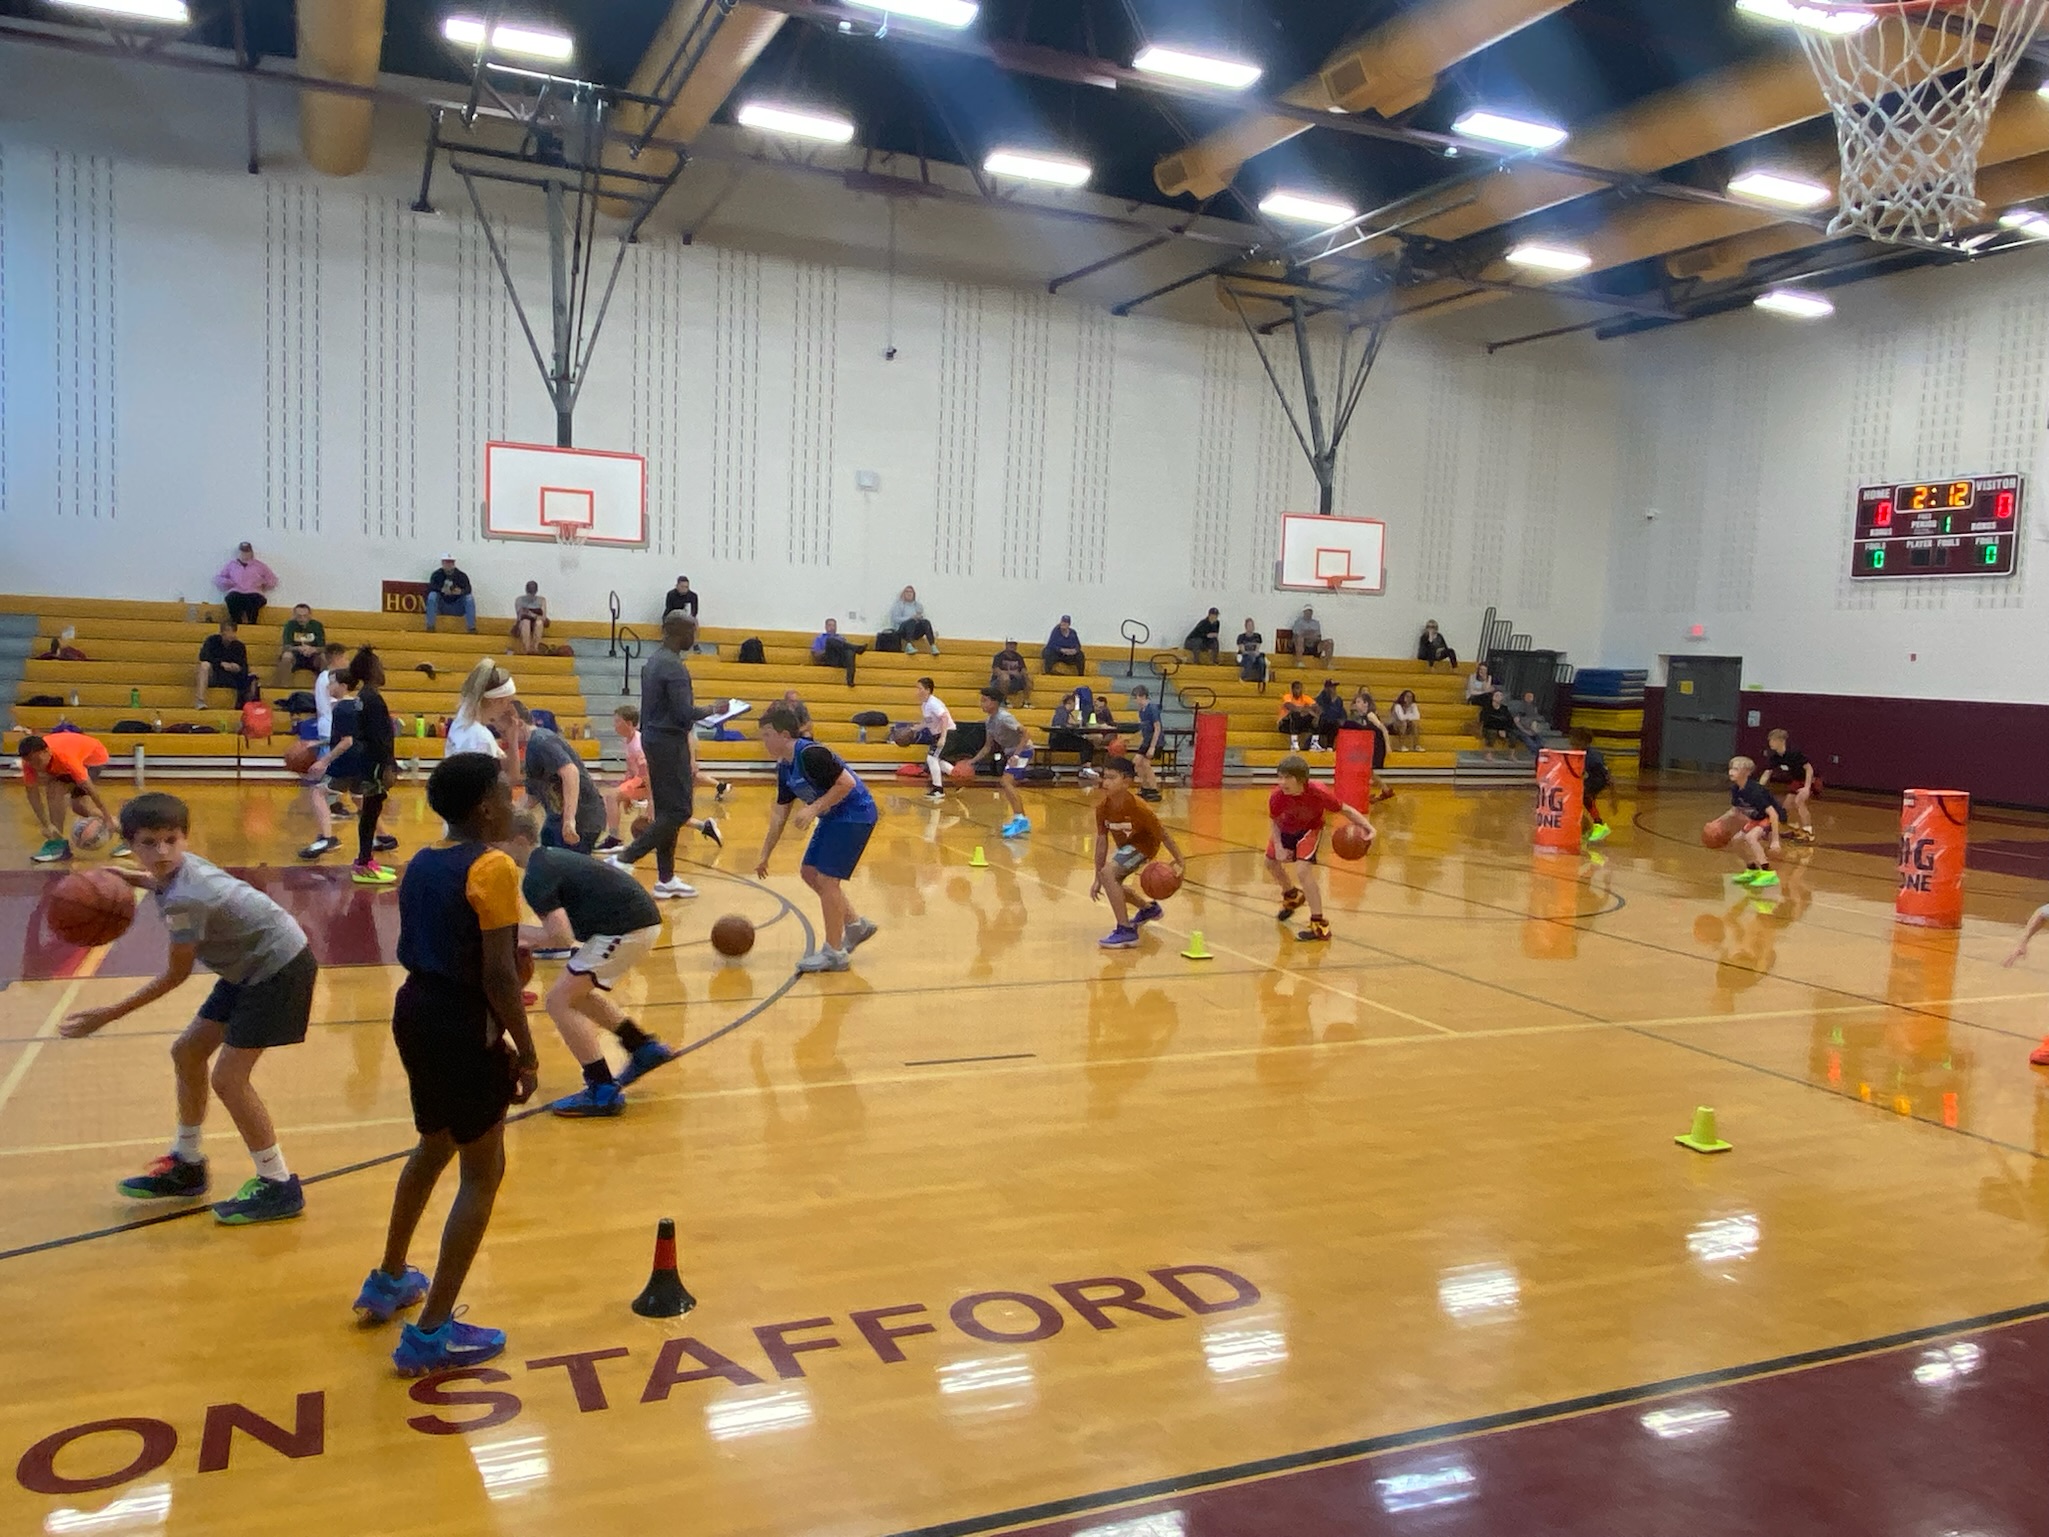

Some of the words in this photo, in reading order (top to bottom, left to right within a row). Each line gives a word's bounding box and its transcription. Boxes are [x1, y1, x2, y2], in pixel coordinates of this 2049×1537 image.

[1863, 488, 1891, 500] HOME
[1913, 482, 1968, 509] 2:12
[1976, 478, 2016, 491] VISITOR
[1876, 501, 1892, 527] 0
[1997, 492, 2013, 518] 0
[1873, 550, 1885, 568] 0
[1985, 545, 1997, 564] 0
[1537, 785, 1563, 812] IG
[1899, 837, 1934, 871] IG
[16, 1390, 325, 1494] ON
[407, 1264, 1261, 1435] STAFFORD
